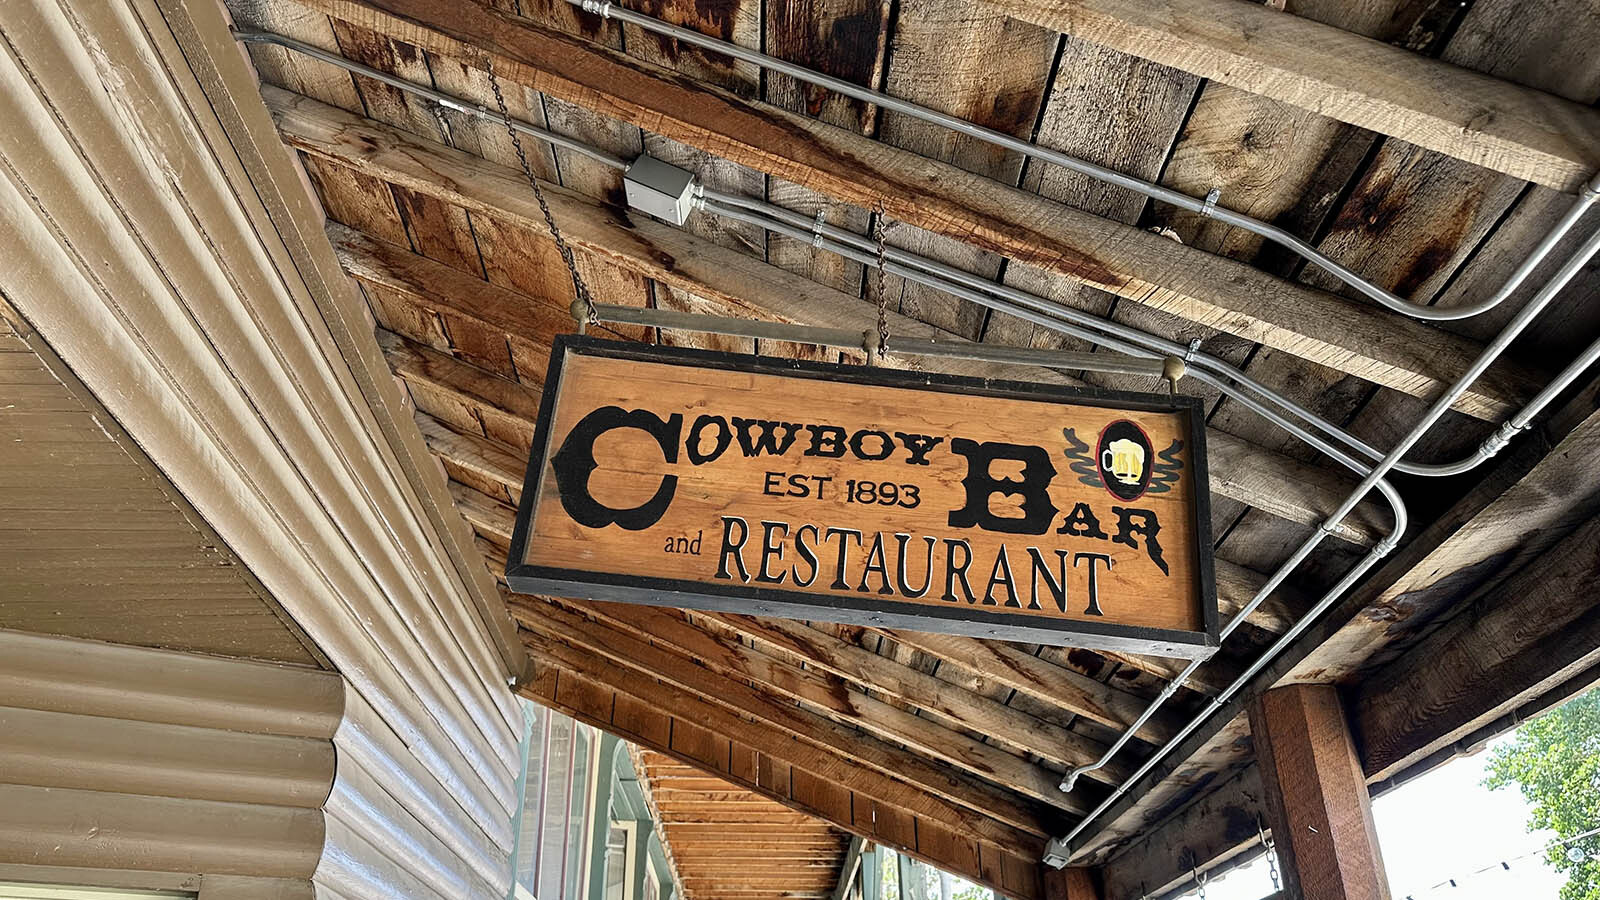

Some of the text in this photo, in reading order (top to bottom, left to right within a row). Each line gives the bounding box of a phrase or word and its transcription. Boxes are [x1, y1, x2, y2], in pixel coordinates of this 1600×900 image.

[763, 471, 921, 509] EST 1893
[664, 515, 1113, 617] and RESTAURANT
